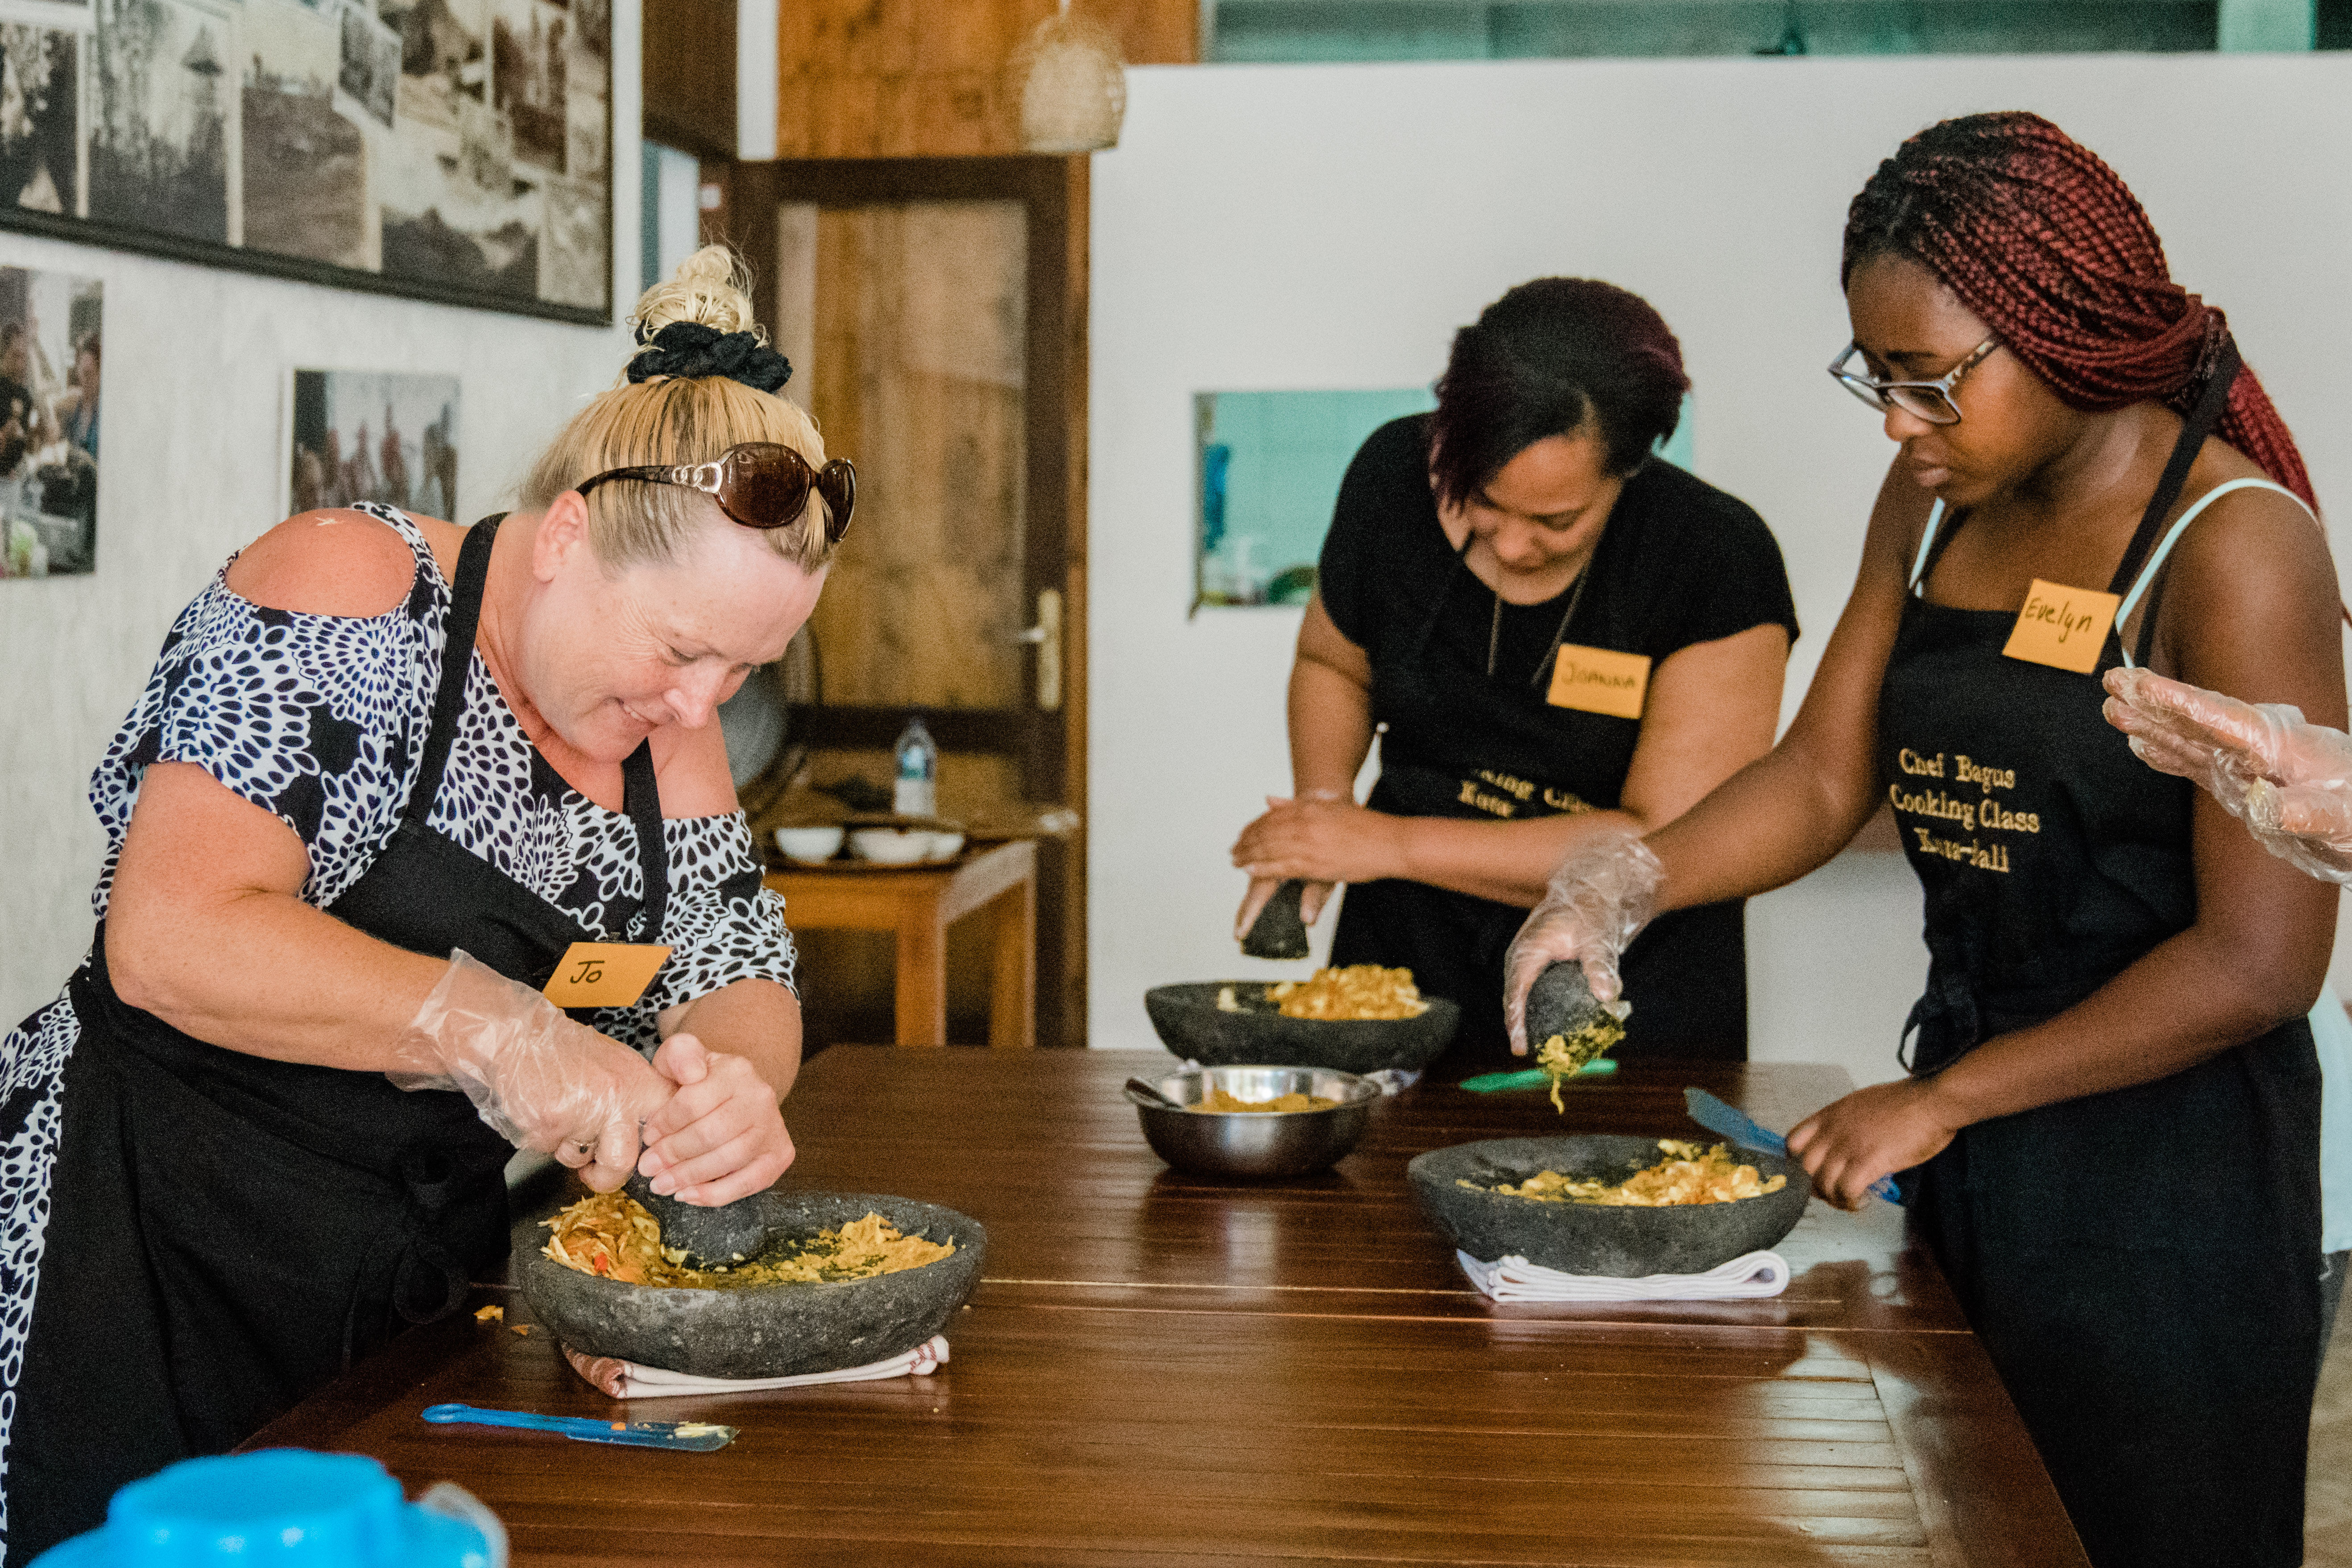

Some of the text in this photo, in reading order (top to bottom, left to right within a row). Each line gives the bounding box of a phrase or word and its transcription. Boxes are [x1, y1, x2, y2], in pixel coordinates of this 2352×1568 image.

[2025, 596, 2092, 644] Evelyn
[1899, 748, 2016, 794] Chef Bagus
[1889, 784, 2040, 833] Cooking Class
[570, 960, 605, 984] Jo
